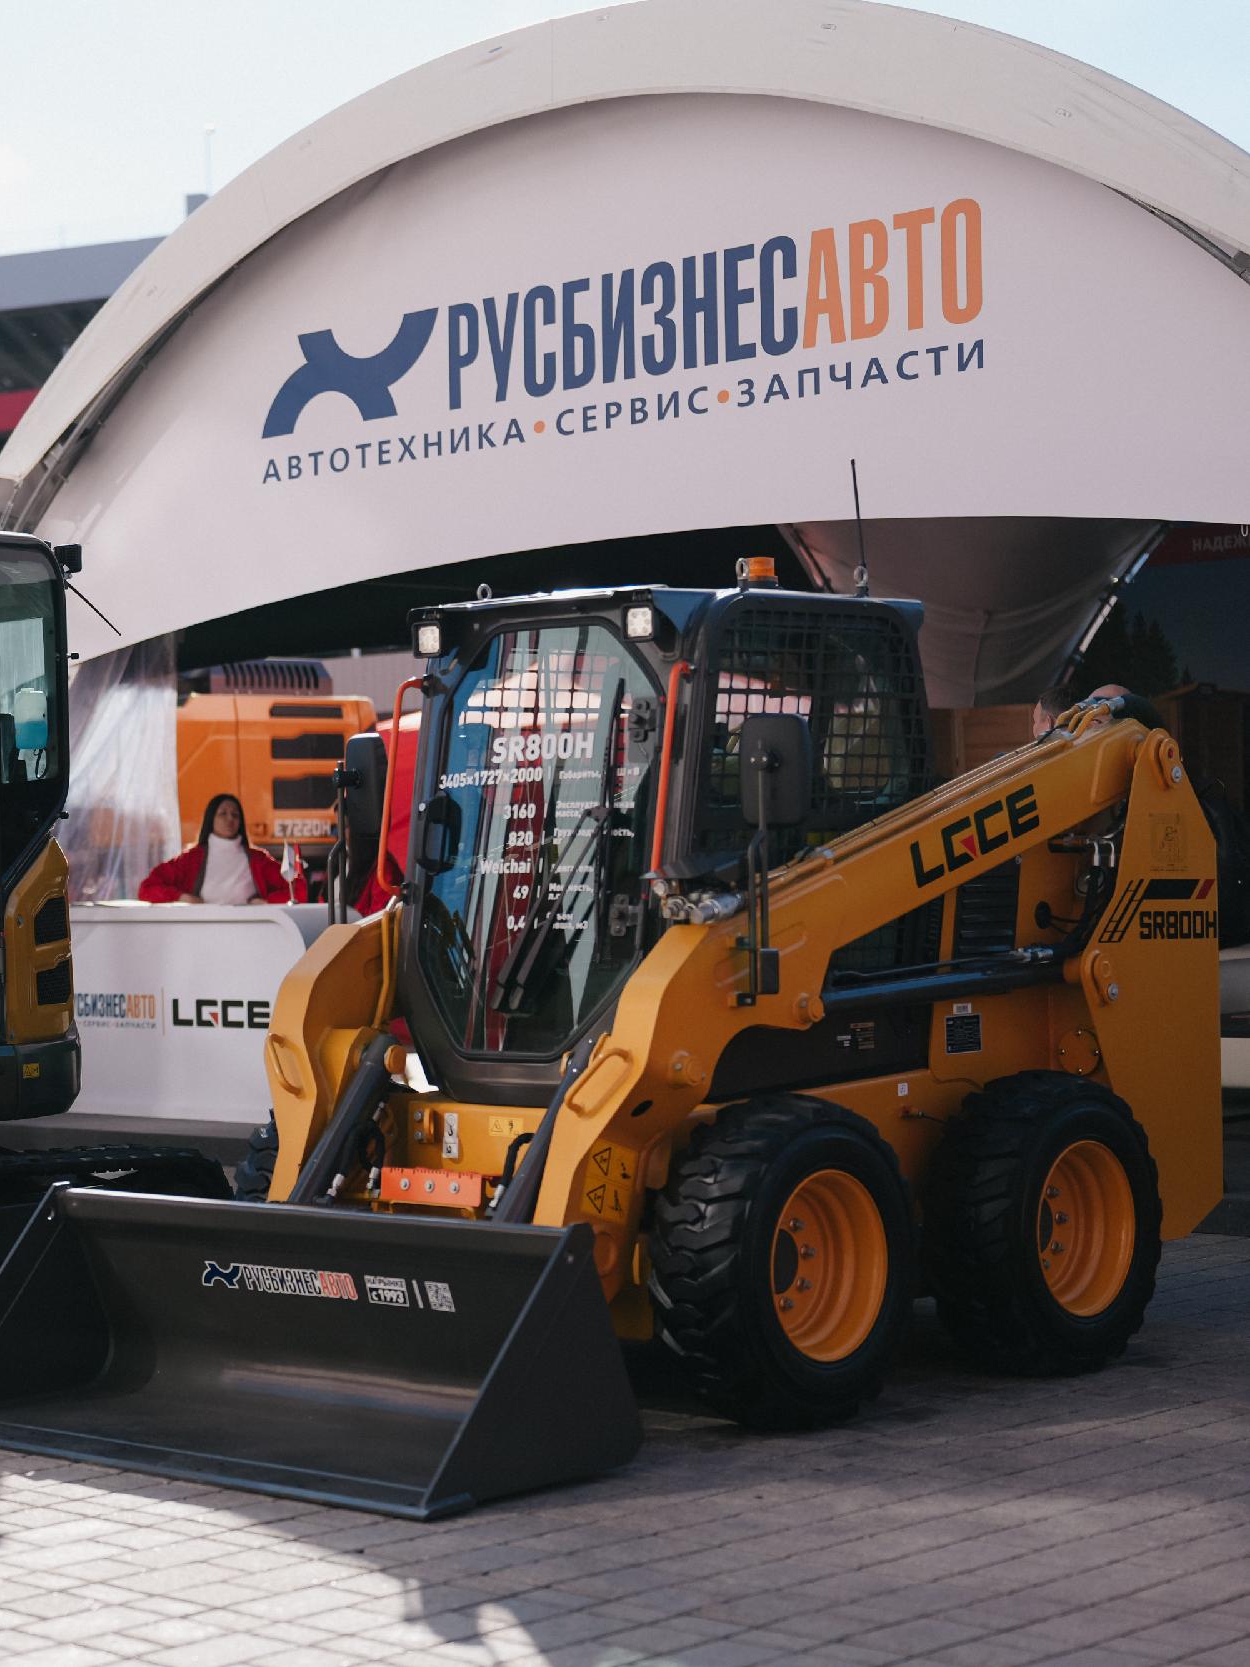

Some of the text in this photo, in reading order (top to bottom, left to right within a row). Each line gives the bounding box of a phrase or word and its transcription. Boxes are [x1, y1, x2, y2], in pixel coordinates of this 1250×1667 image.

[450, 198, 984, 409] РУСБИЗНЕСАВТО
[262, 338, 986, 485] АВТОТЕХНИКА СЕРВИС ЗАПЧАСТИ
[1191, 534, 1250, 552] НАДЕЖ
[491, 732, 594, 764] SR800H
[503, 803, 536, 820] 3160
[508, 830, 533, 847] 820
[910, 783, 1041, 889] LGCE
[480, 857, 531, 874] Weichai
[513, 884, 529, 899] 49
[1139, 911, 1218, 940] SR800H
[75, 993, 156, 1019] СБИЗНЕСАВТО
[172, 998, 270, 1029] LGCE
[242, 1264, 358, 1300] РУСБИЗНЕСАВТО
